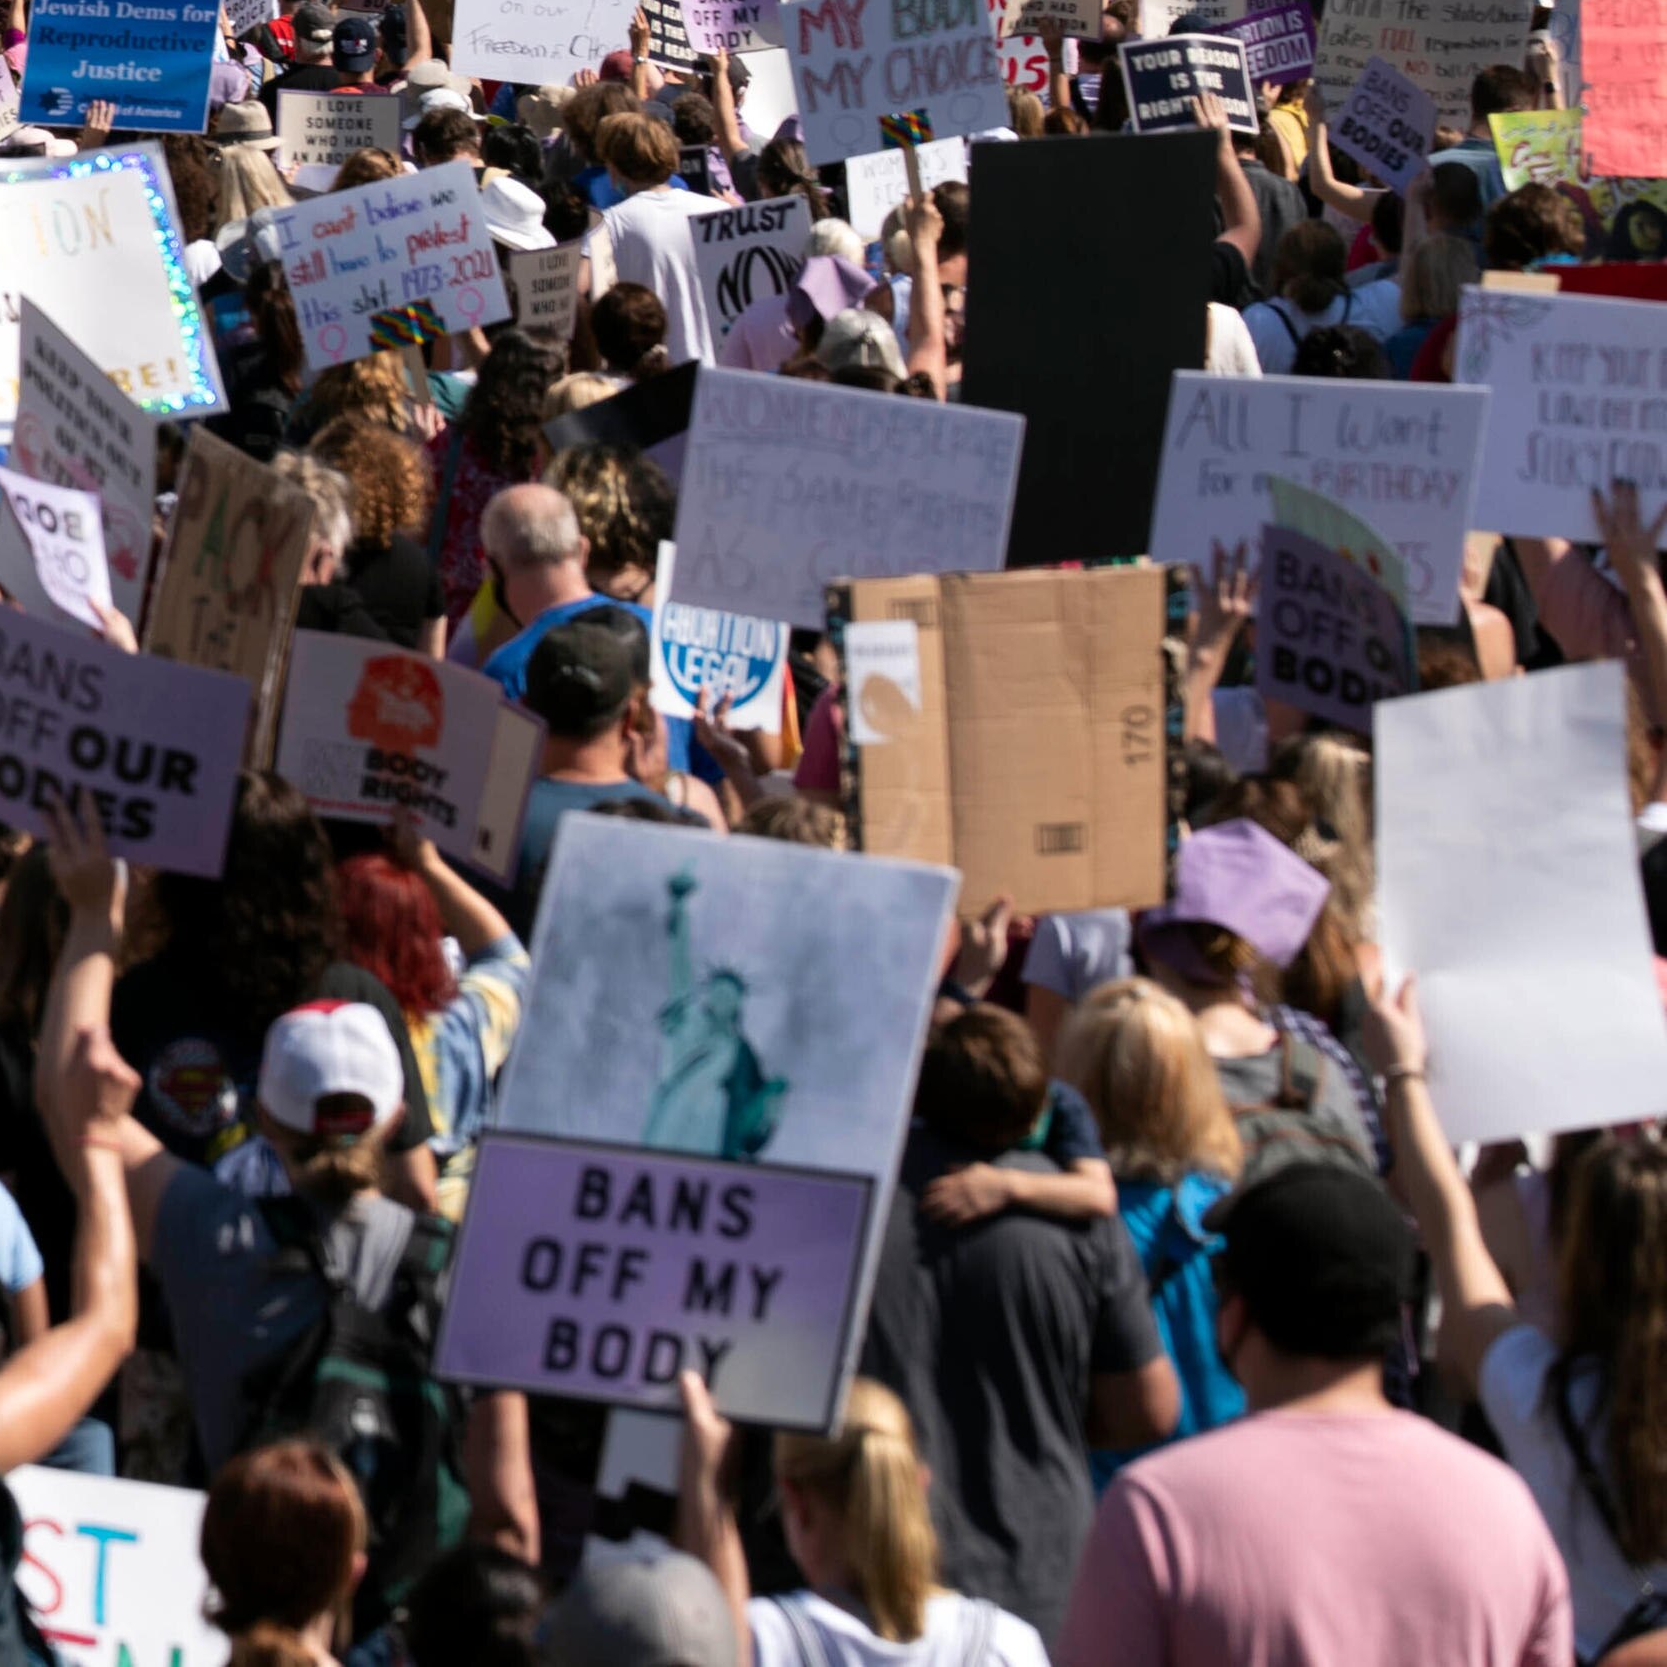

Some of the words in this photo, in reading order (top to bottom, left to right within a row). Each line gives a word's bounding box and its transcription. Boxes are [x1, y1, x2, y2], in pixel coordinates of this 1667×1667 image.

[115, 0, 178, 23] Dems
[182, 3, 216, 24] for
[692, 7, 726, 27] OFF
[733, 5, 760, 23] MY
[37, 25, 207, 57] Reproductive
[1131, 50, 1180, 72] YOUR
[1187, 48, 1240, 70] REASON
[72, 59, 163, 84] Justice
[799, 53, 871, 113] MY
[884, 36, 999, 105] CHOICE
[1169, 73, 1188, 89] IS
[1196, 73, 1224, 90] THE
[278, 215, 300, 251] I
[363, 192, 424, 227] believe
[429, 188, 459, 208] we
[697, 200, 797, 246] TRUST
[290, 249, 328, 287] still
[329, 242, 369, 275] have
[376, 236, 397, 263] to
[301, 299, 341, 330] this
[352, 280, 393, 316] shit
[362, 746, 450, 792] BODY
[358, 776, 459, 832] RIGHTS
[571, 1164, 758, 1241] BANS
[518, 1236, 648, 1306] OFF
[681, 1254, 786, 1326] MY
[540, 1316, 731, 1395] BODY
